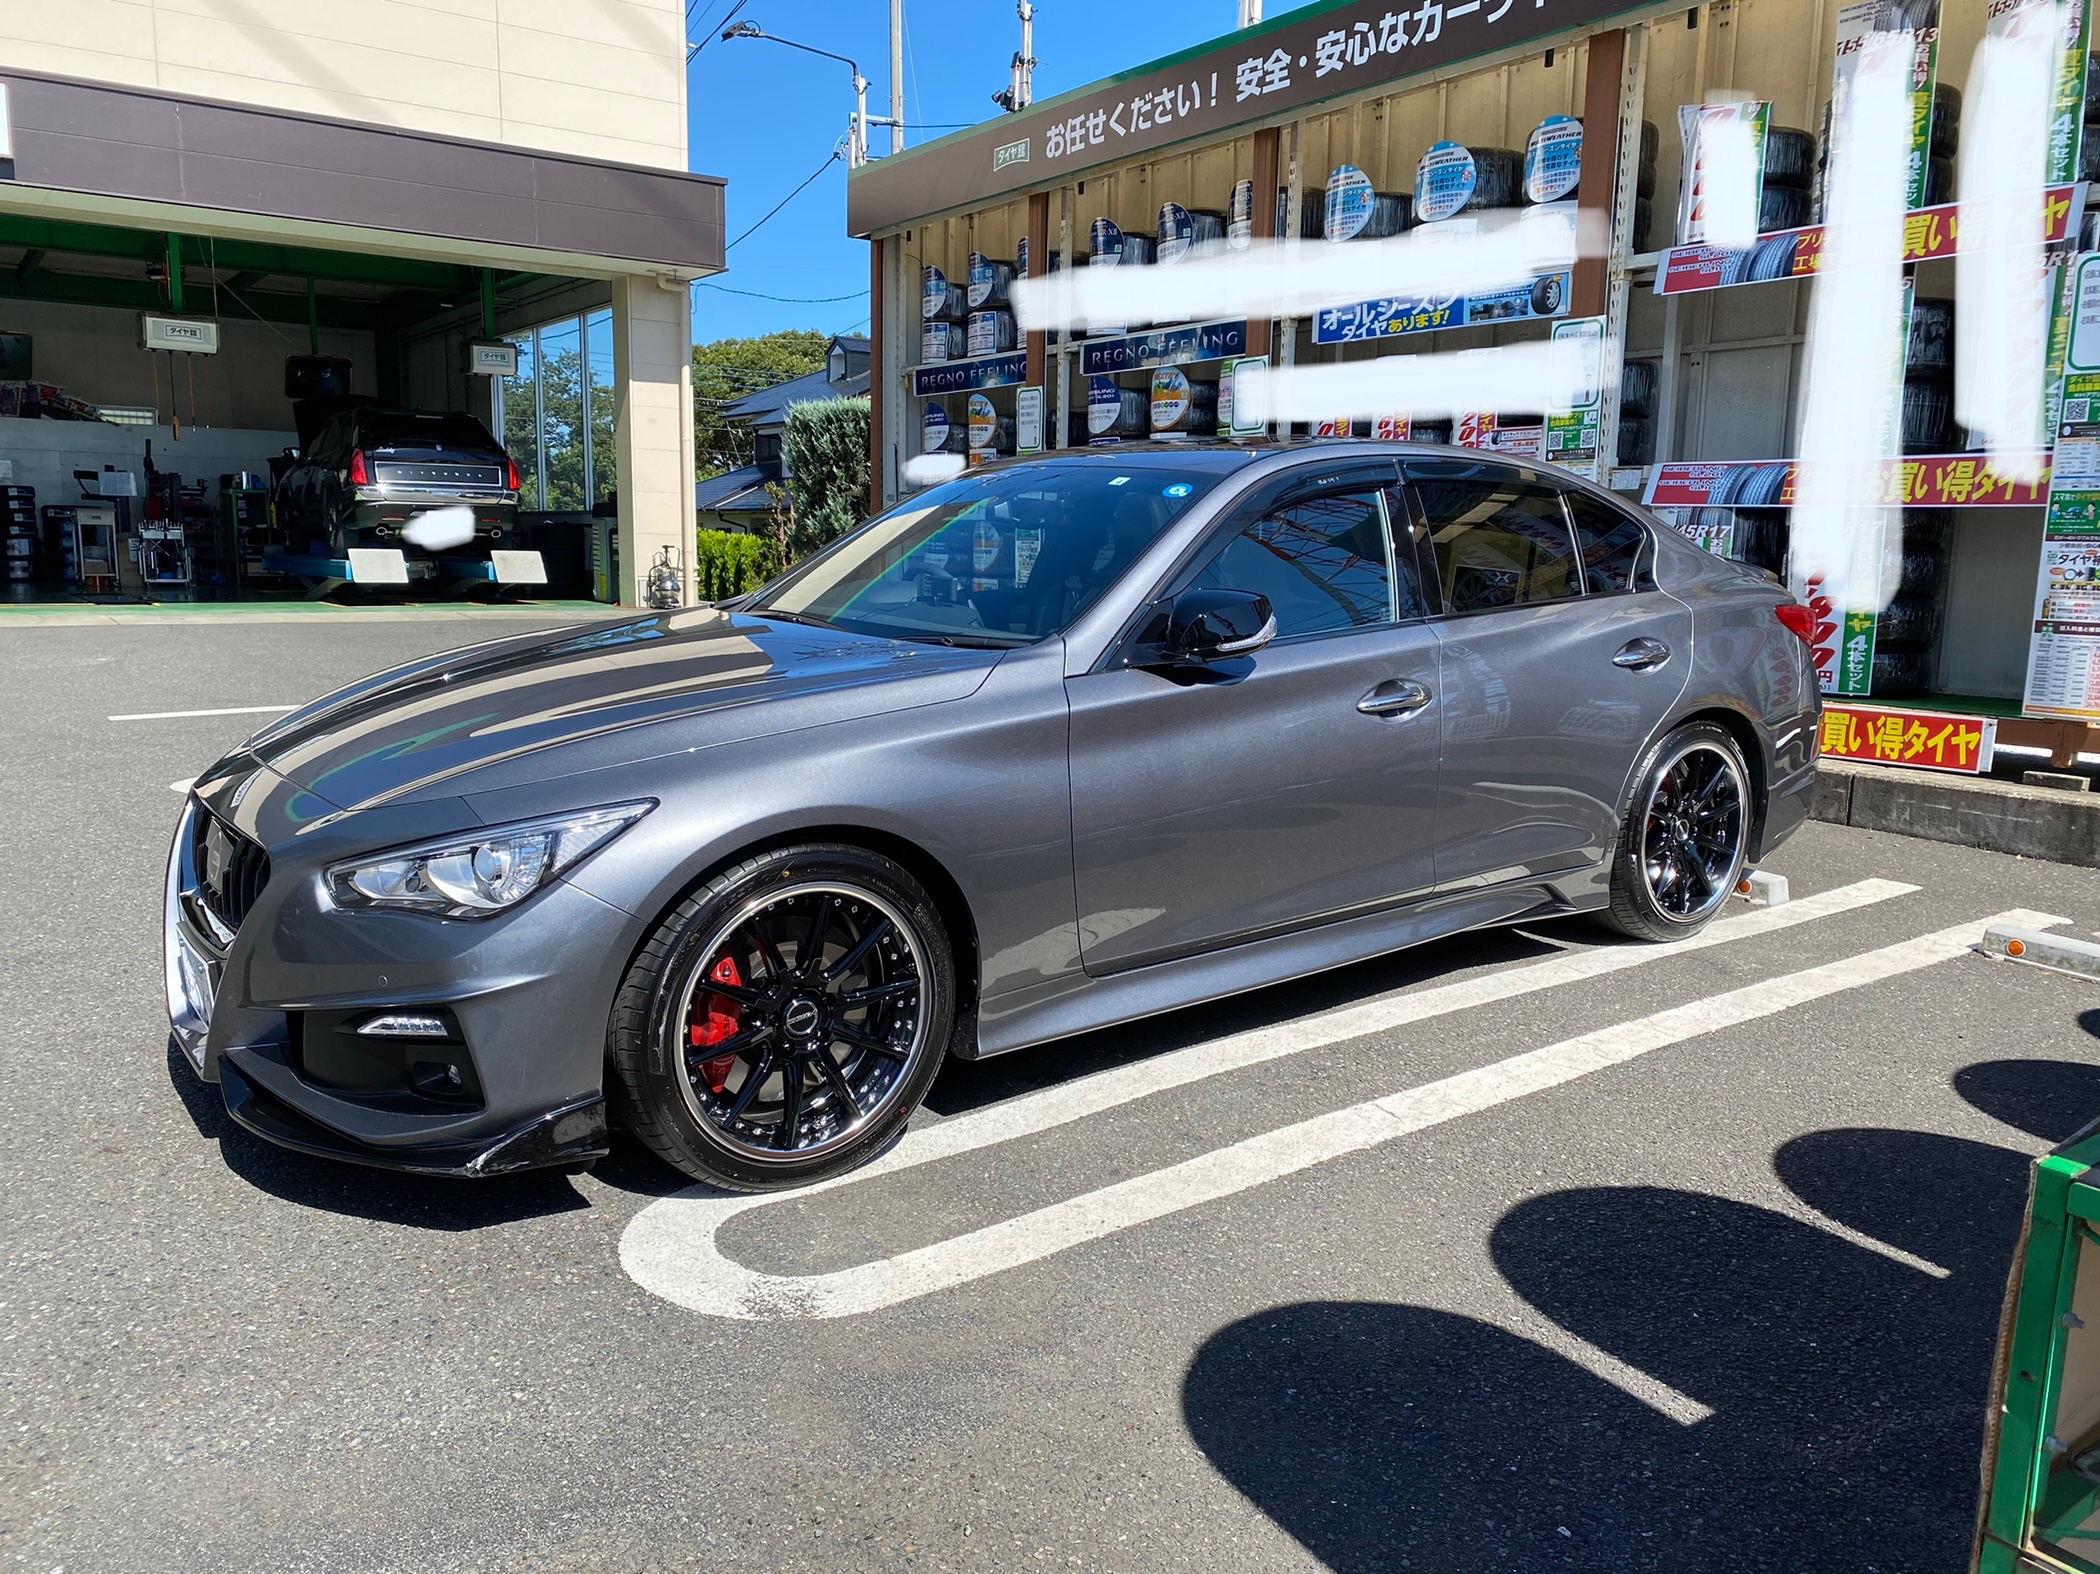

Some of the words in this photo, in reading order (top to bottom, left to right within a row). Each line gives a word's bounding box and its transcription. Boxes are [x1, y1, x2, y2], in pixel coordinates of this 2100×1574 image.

[1046, 72, 1218, 159] お任せください！
[1091, 344, 1150, 365] REGNO
[1157, 331, 1239, 351] FEELING
[921, 370, 965, 388] REGNO
[1864, 460, 2052, 503] お買い得タイヤ
[1820, 711, 1981, 766] 買い得タイヤ
